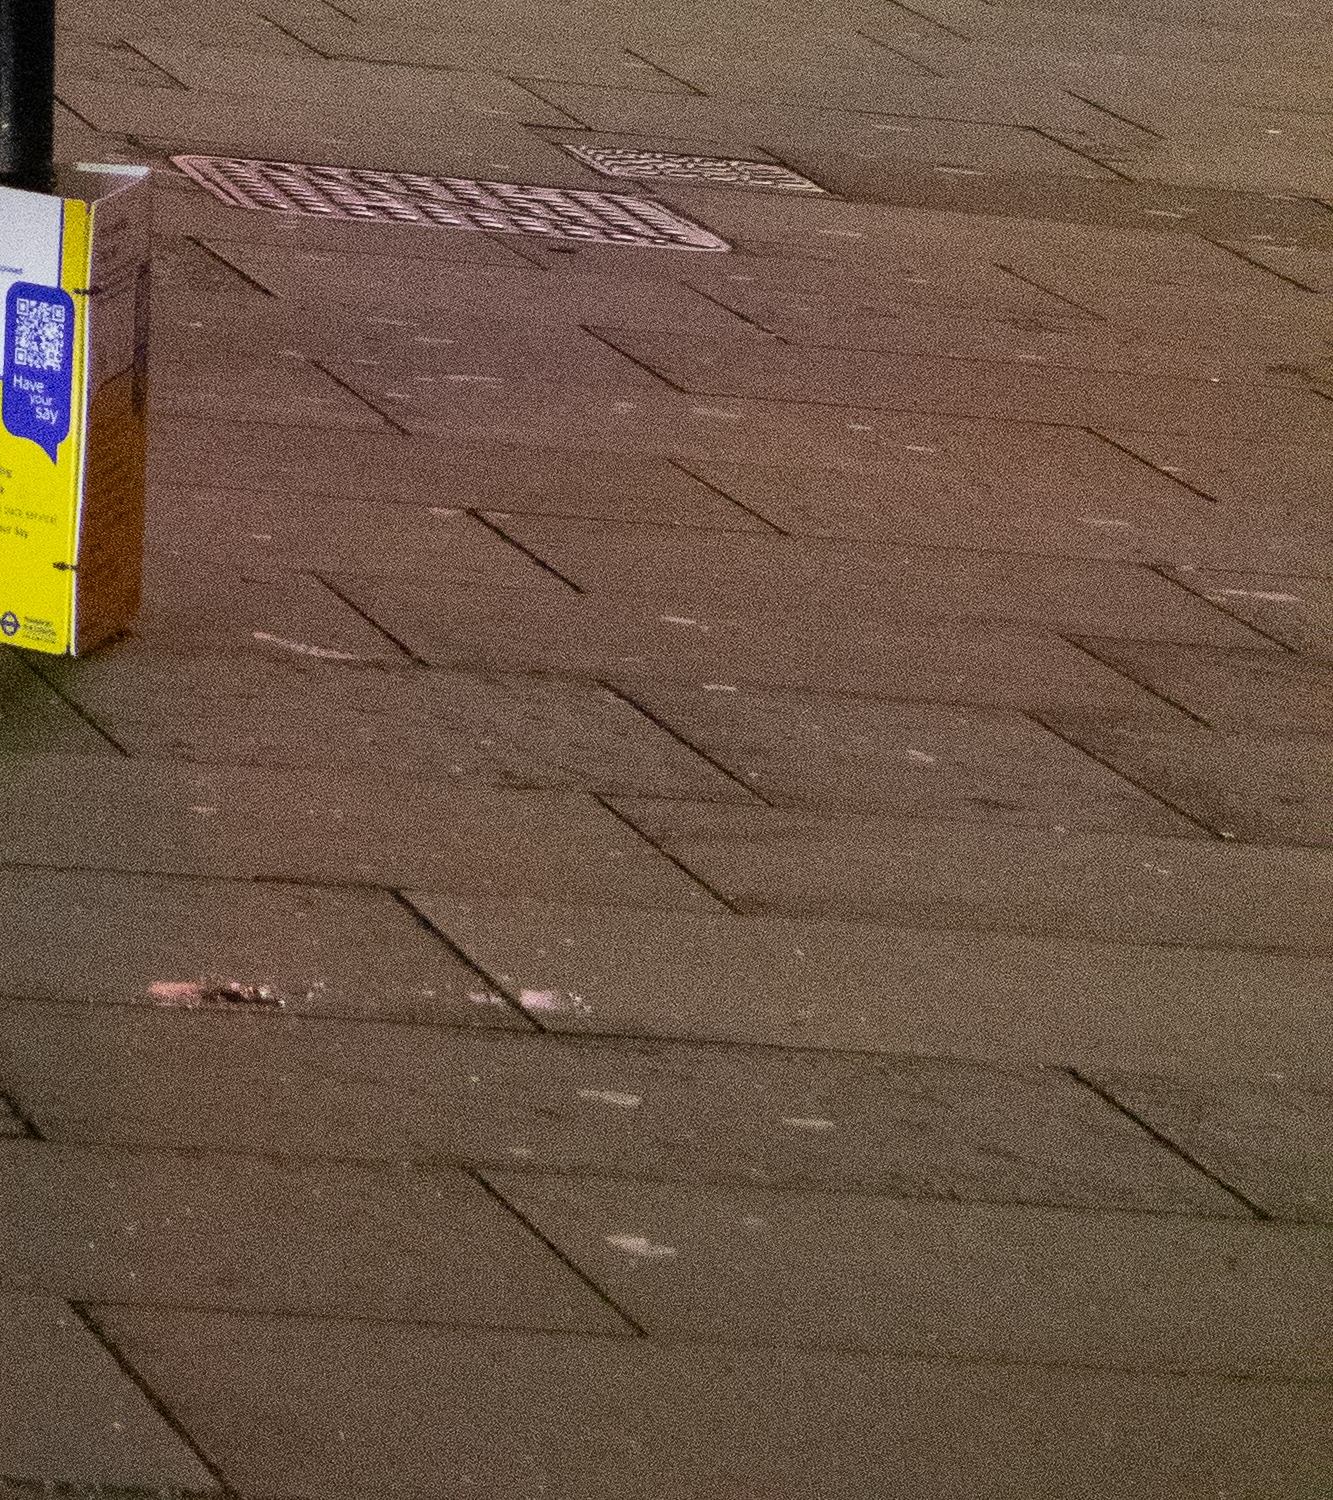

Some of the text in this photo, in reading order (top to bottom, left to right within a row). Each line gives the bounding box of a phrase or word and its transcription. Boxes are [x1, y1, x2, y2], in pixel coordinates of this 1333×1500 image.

[12, 374, 45, 394] Have
[29, 393, 54, 407] your
[34, 405, 59, 425] say
